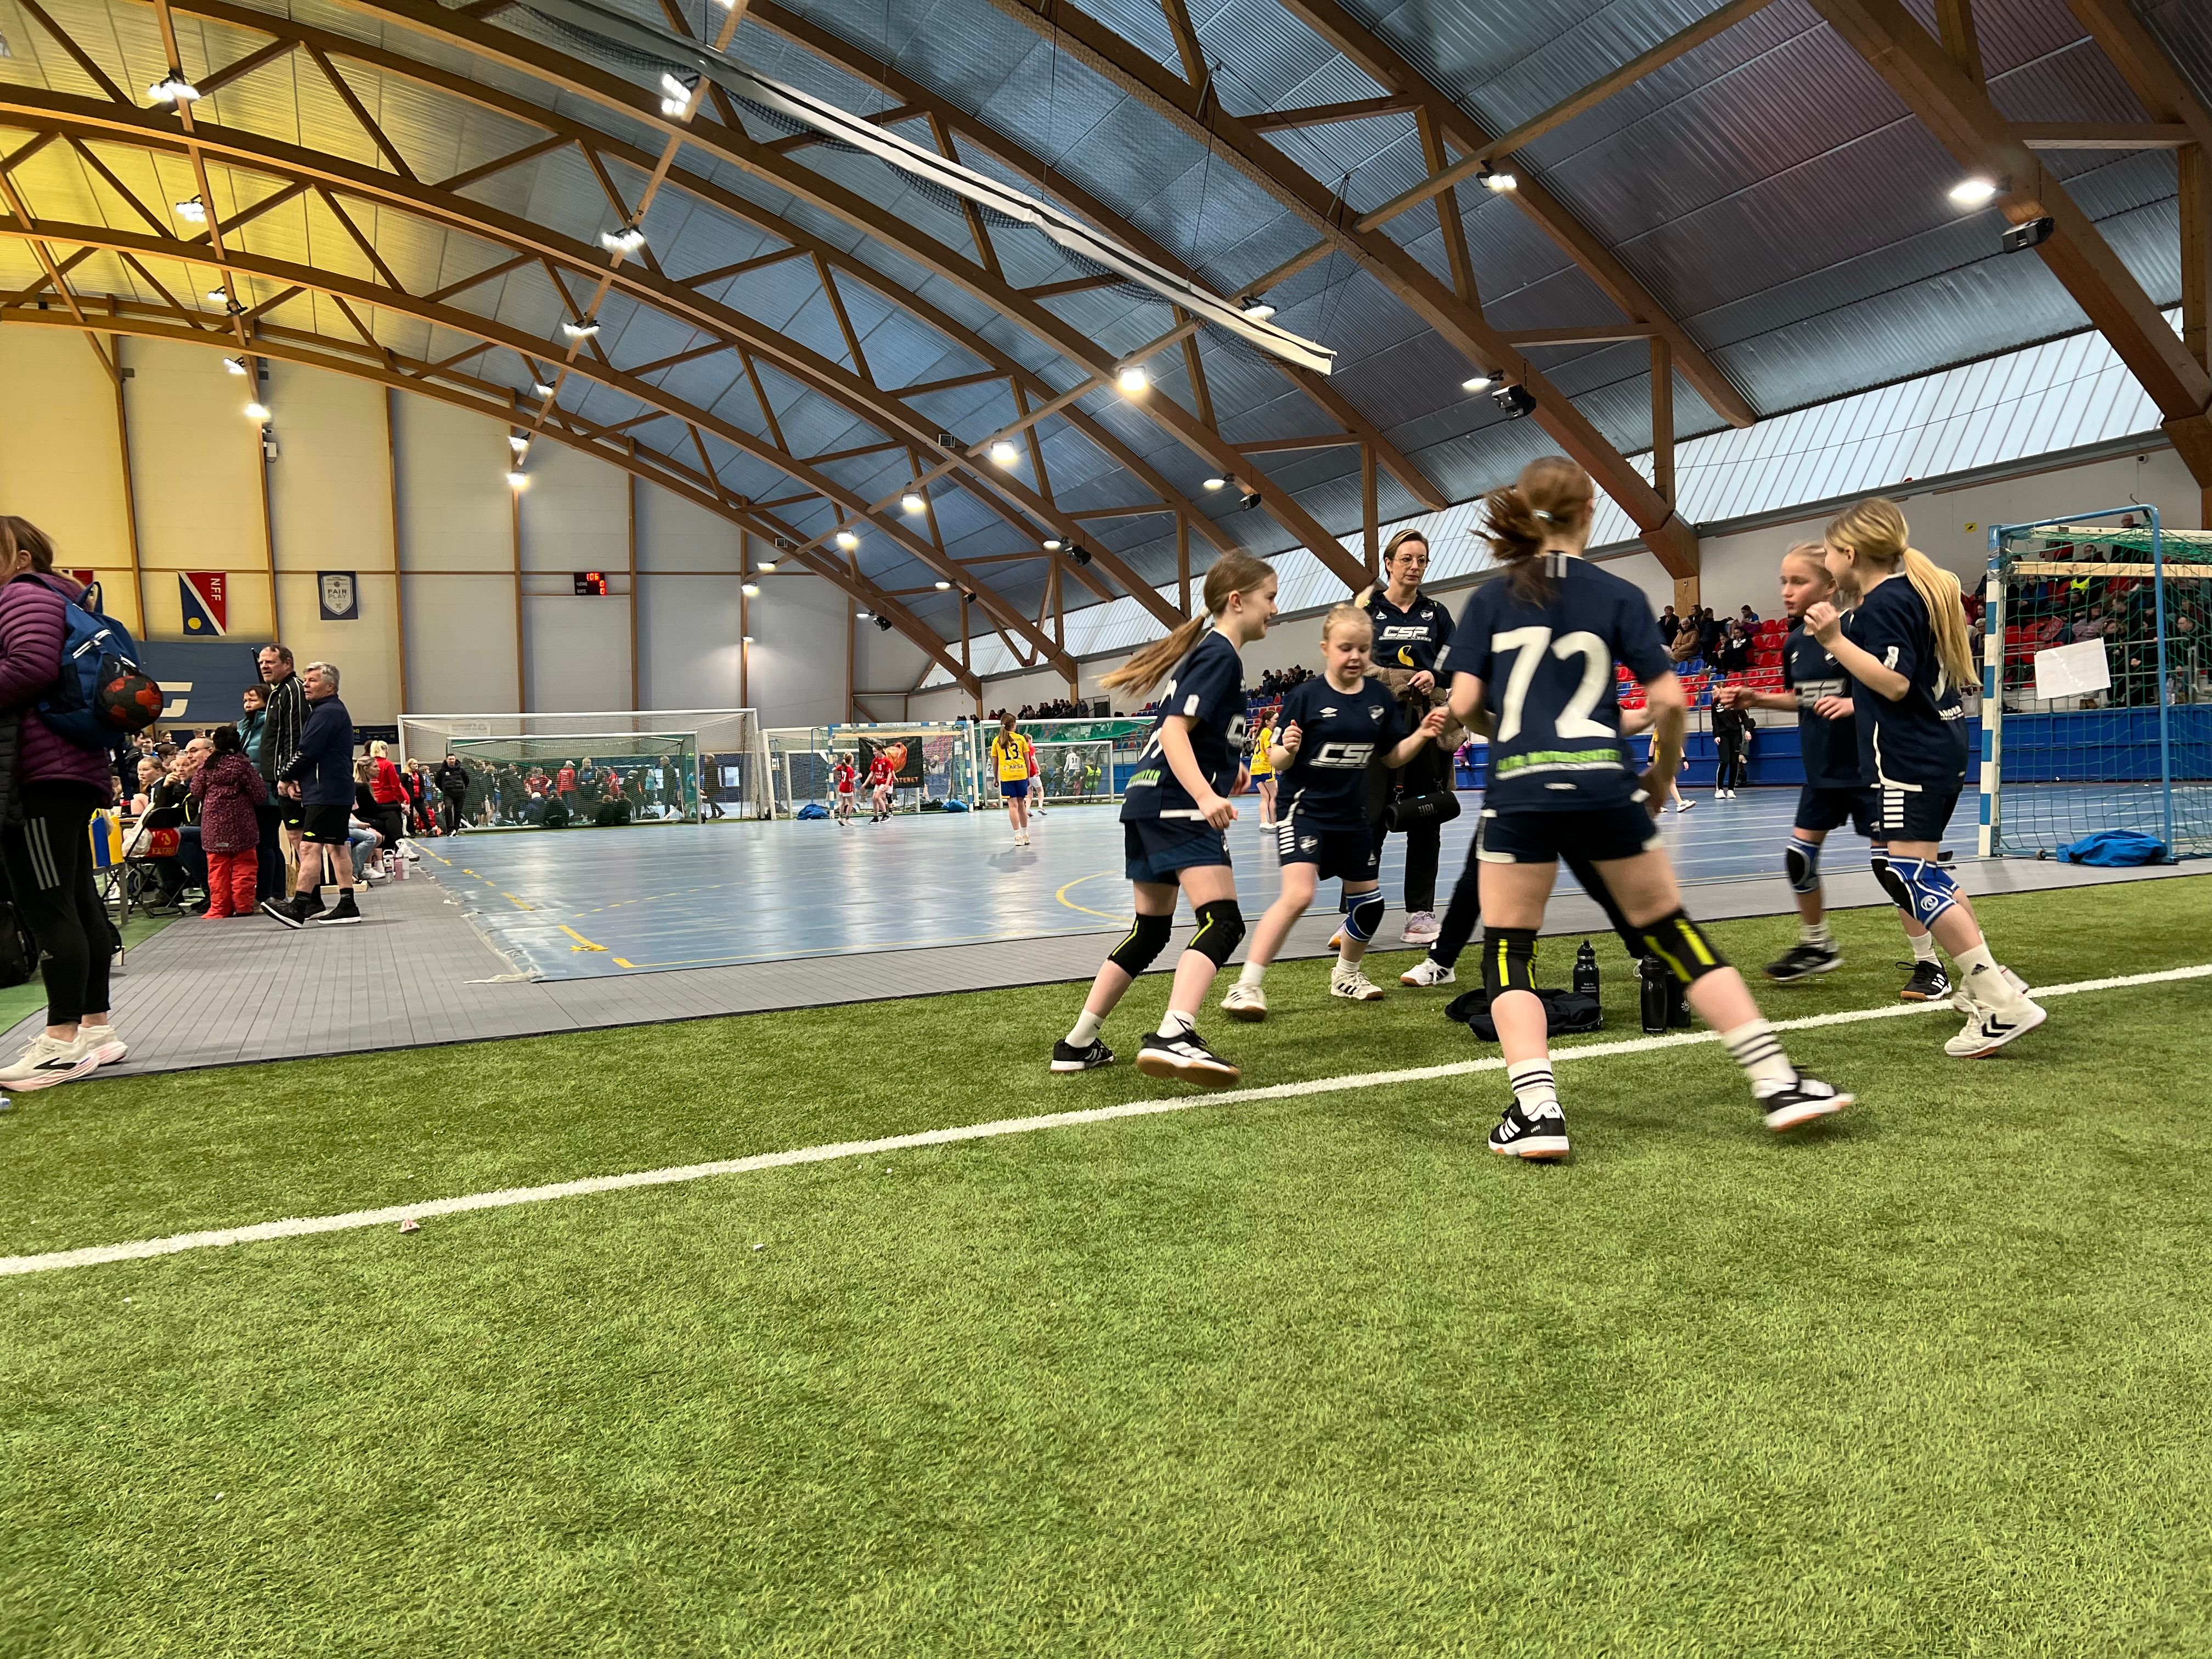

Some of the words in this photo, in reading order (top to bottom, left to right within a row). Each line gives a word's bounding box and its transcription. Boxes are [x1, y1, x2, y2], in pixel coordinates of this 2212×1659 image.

[1383, 625, 1429, 637] CSP
[1491, 626, 1617, 743] 72
[1005, 743, 1019, 760] 13
[1420, 803, 1438, 816] JBL
